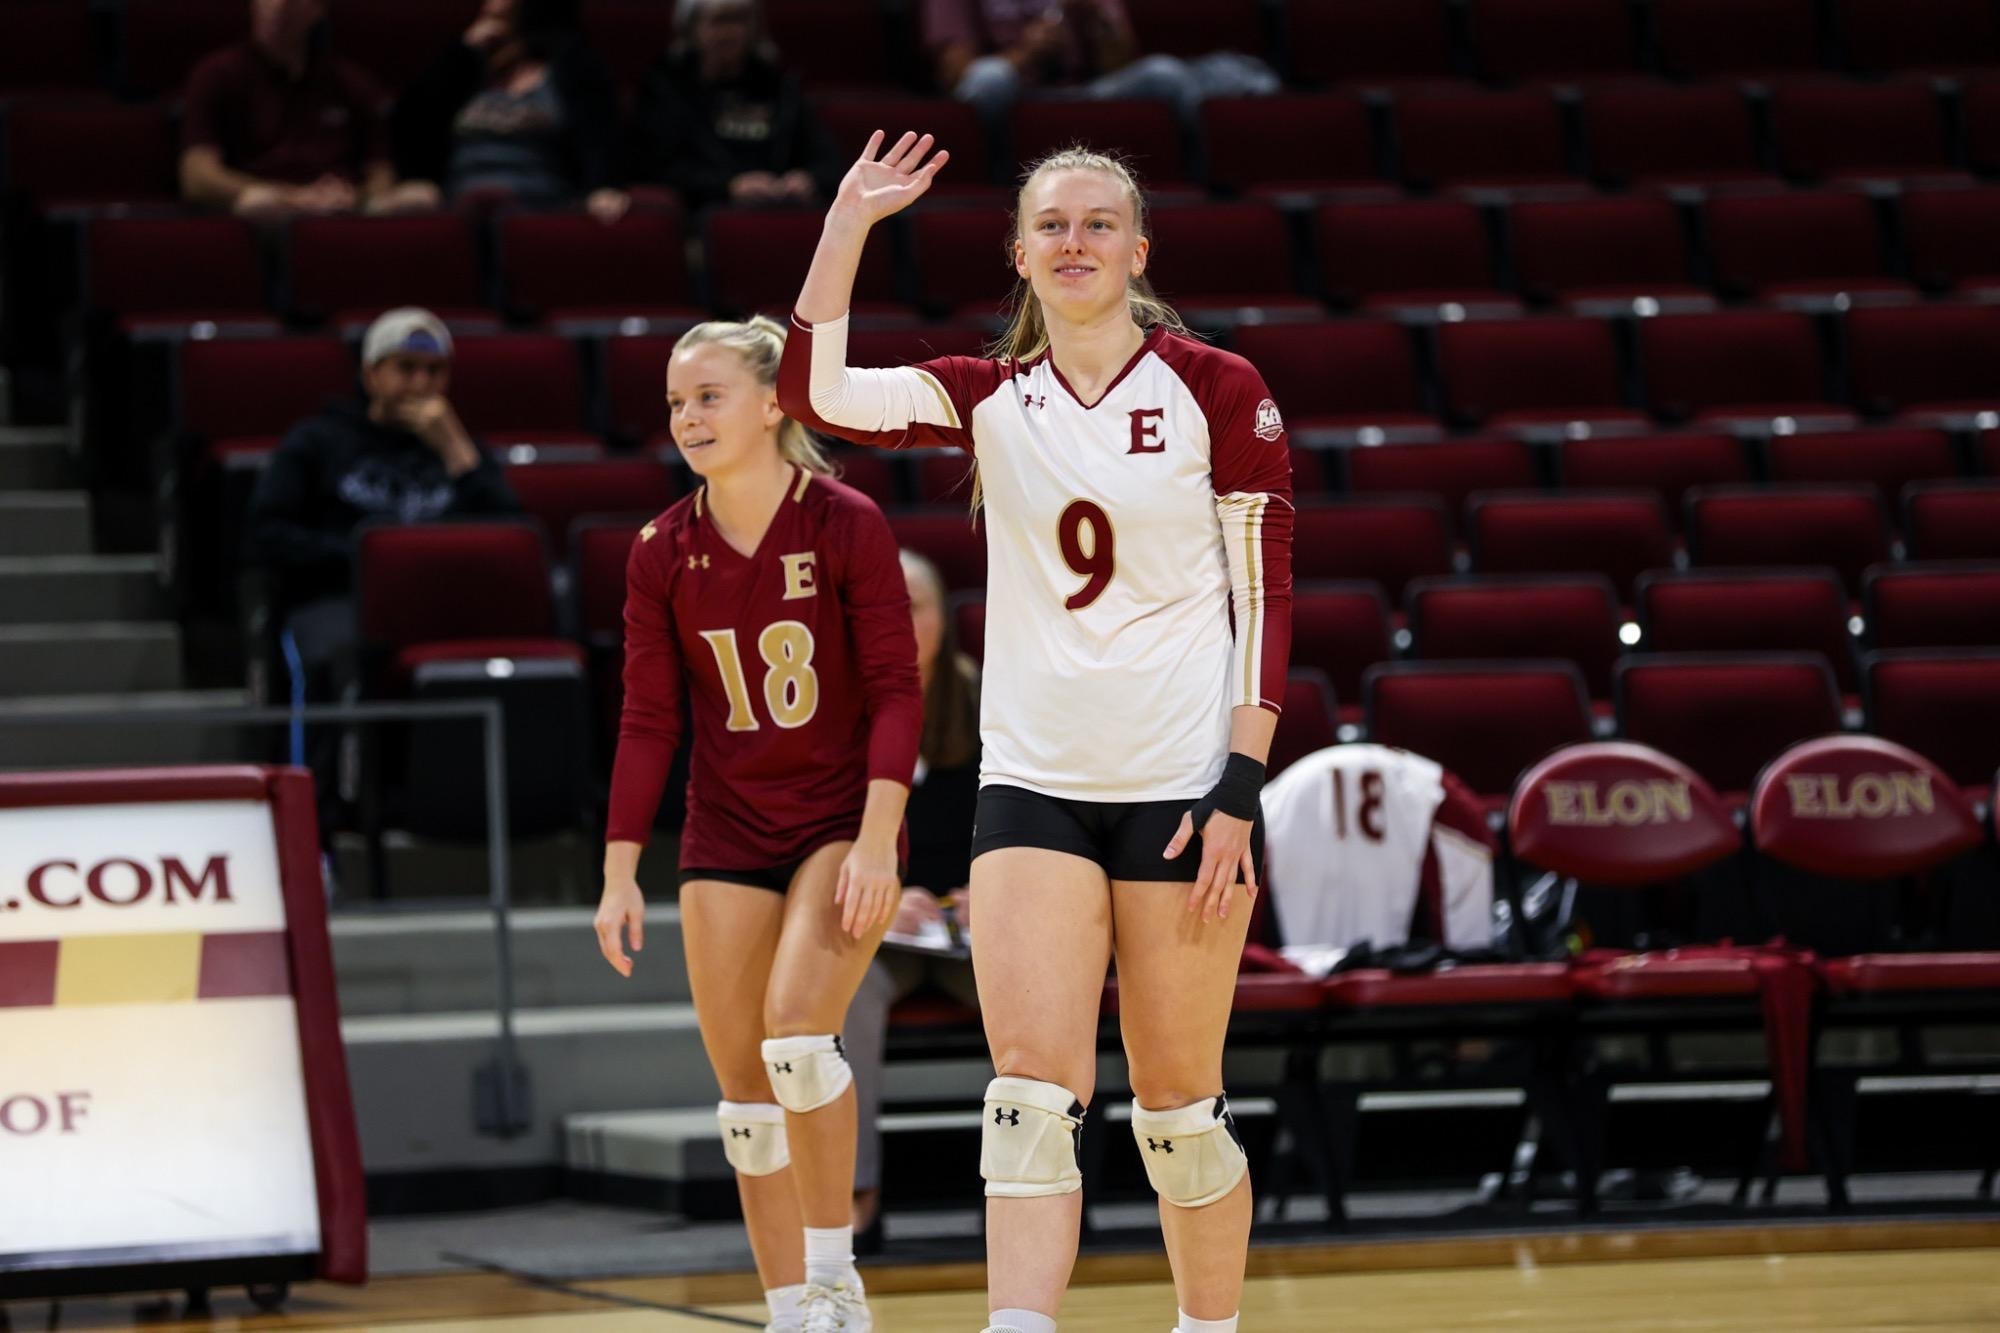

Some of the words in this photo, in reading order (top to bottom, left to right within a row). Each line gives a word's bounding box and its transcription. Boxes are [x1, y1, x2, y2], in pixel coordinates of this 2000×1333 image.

[1125, 407, 1166, 454] E
[779, 551, 817, 600] E
[1056, 497, 1117, 611] 9
[698, 620, 819, 731] 18
[1332, 766, 1386, 845] 18
[1542, 779, 1694, 826] ELON
[1782, 770, 1936, 818] ELON
[0, 853, 236, 909] .COM
[0, 1091, 92, 1136] OF
